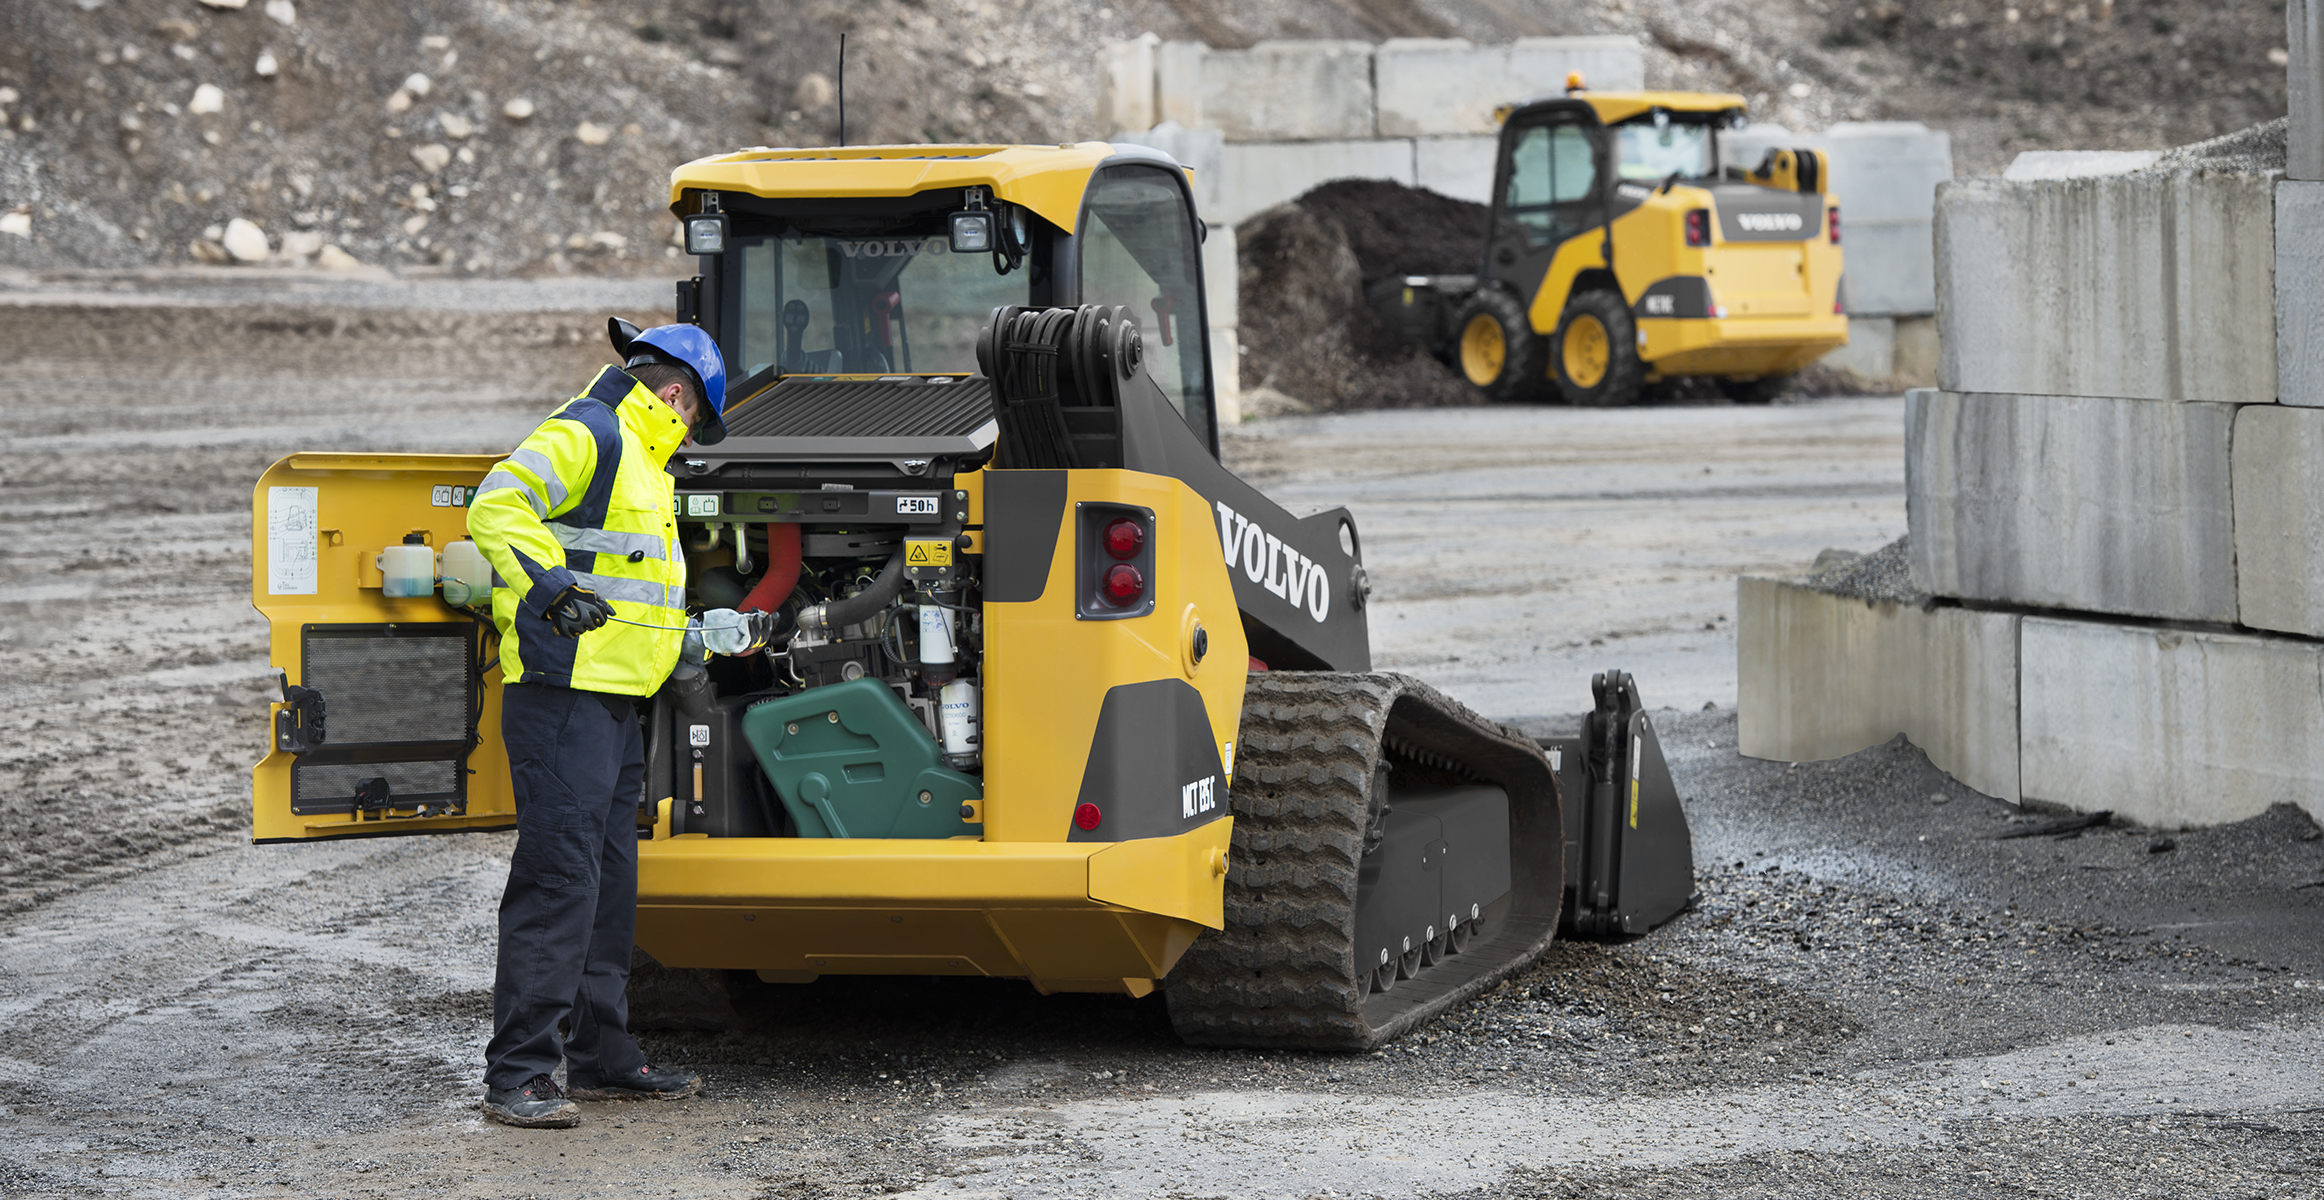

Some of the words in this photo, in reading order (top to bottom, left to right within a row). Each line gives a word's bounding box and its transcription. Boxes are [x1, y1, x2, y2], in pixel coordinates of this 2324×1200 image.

[1737, 213, 1803, 231] VOLVO
[838, 240, 948, 257] VOLVO
[910, 500, 925, 512] 50
[926, 499, 934, 511] h
[1217, 500, 1330, 623] VOLVO
[1182, 781, 1198, 819] MCT
[1209, 775, 1216, 809] C
